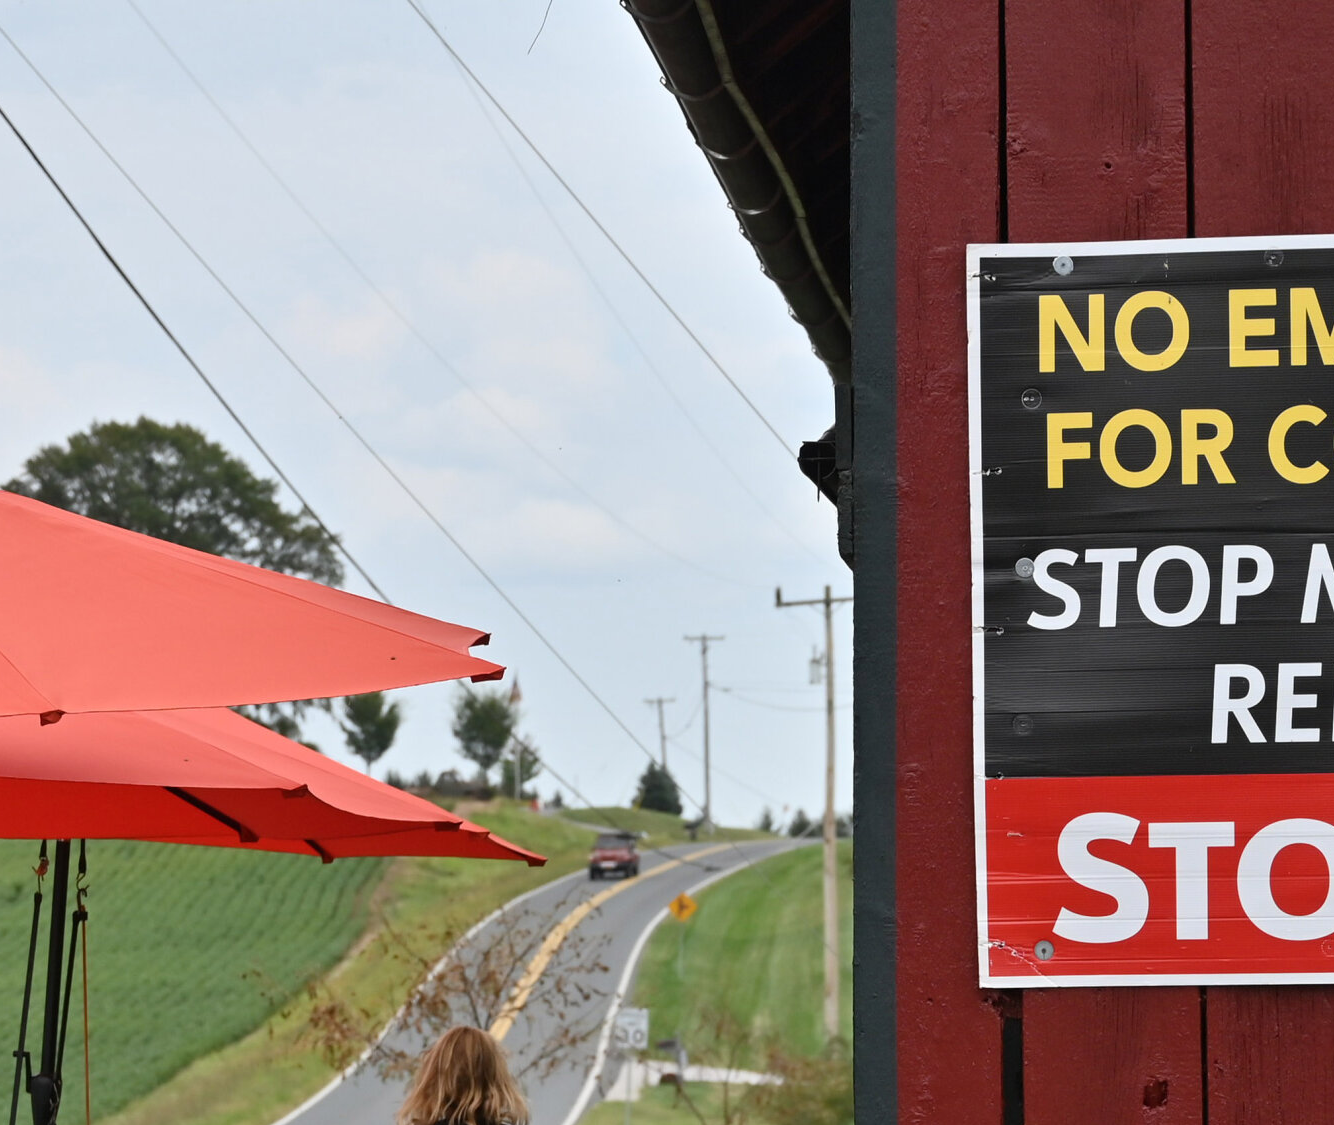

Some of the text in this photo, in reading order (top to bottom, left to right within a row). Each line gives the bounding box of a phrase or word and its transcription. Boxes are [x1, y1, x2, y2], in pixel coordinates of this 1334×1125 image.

[1038, 290, 1191, 373] NO
[1046, 408, 1237, 489] FOR
[1026, 544, 1275, 631] STOP
